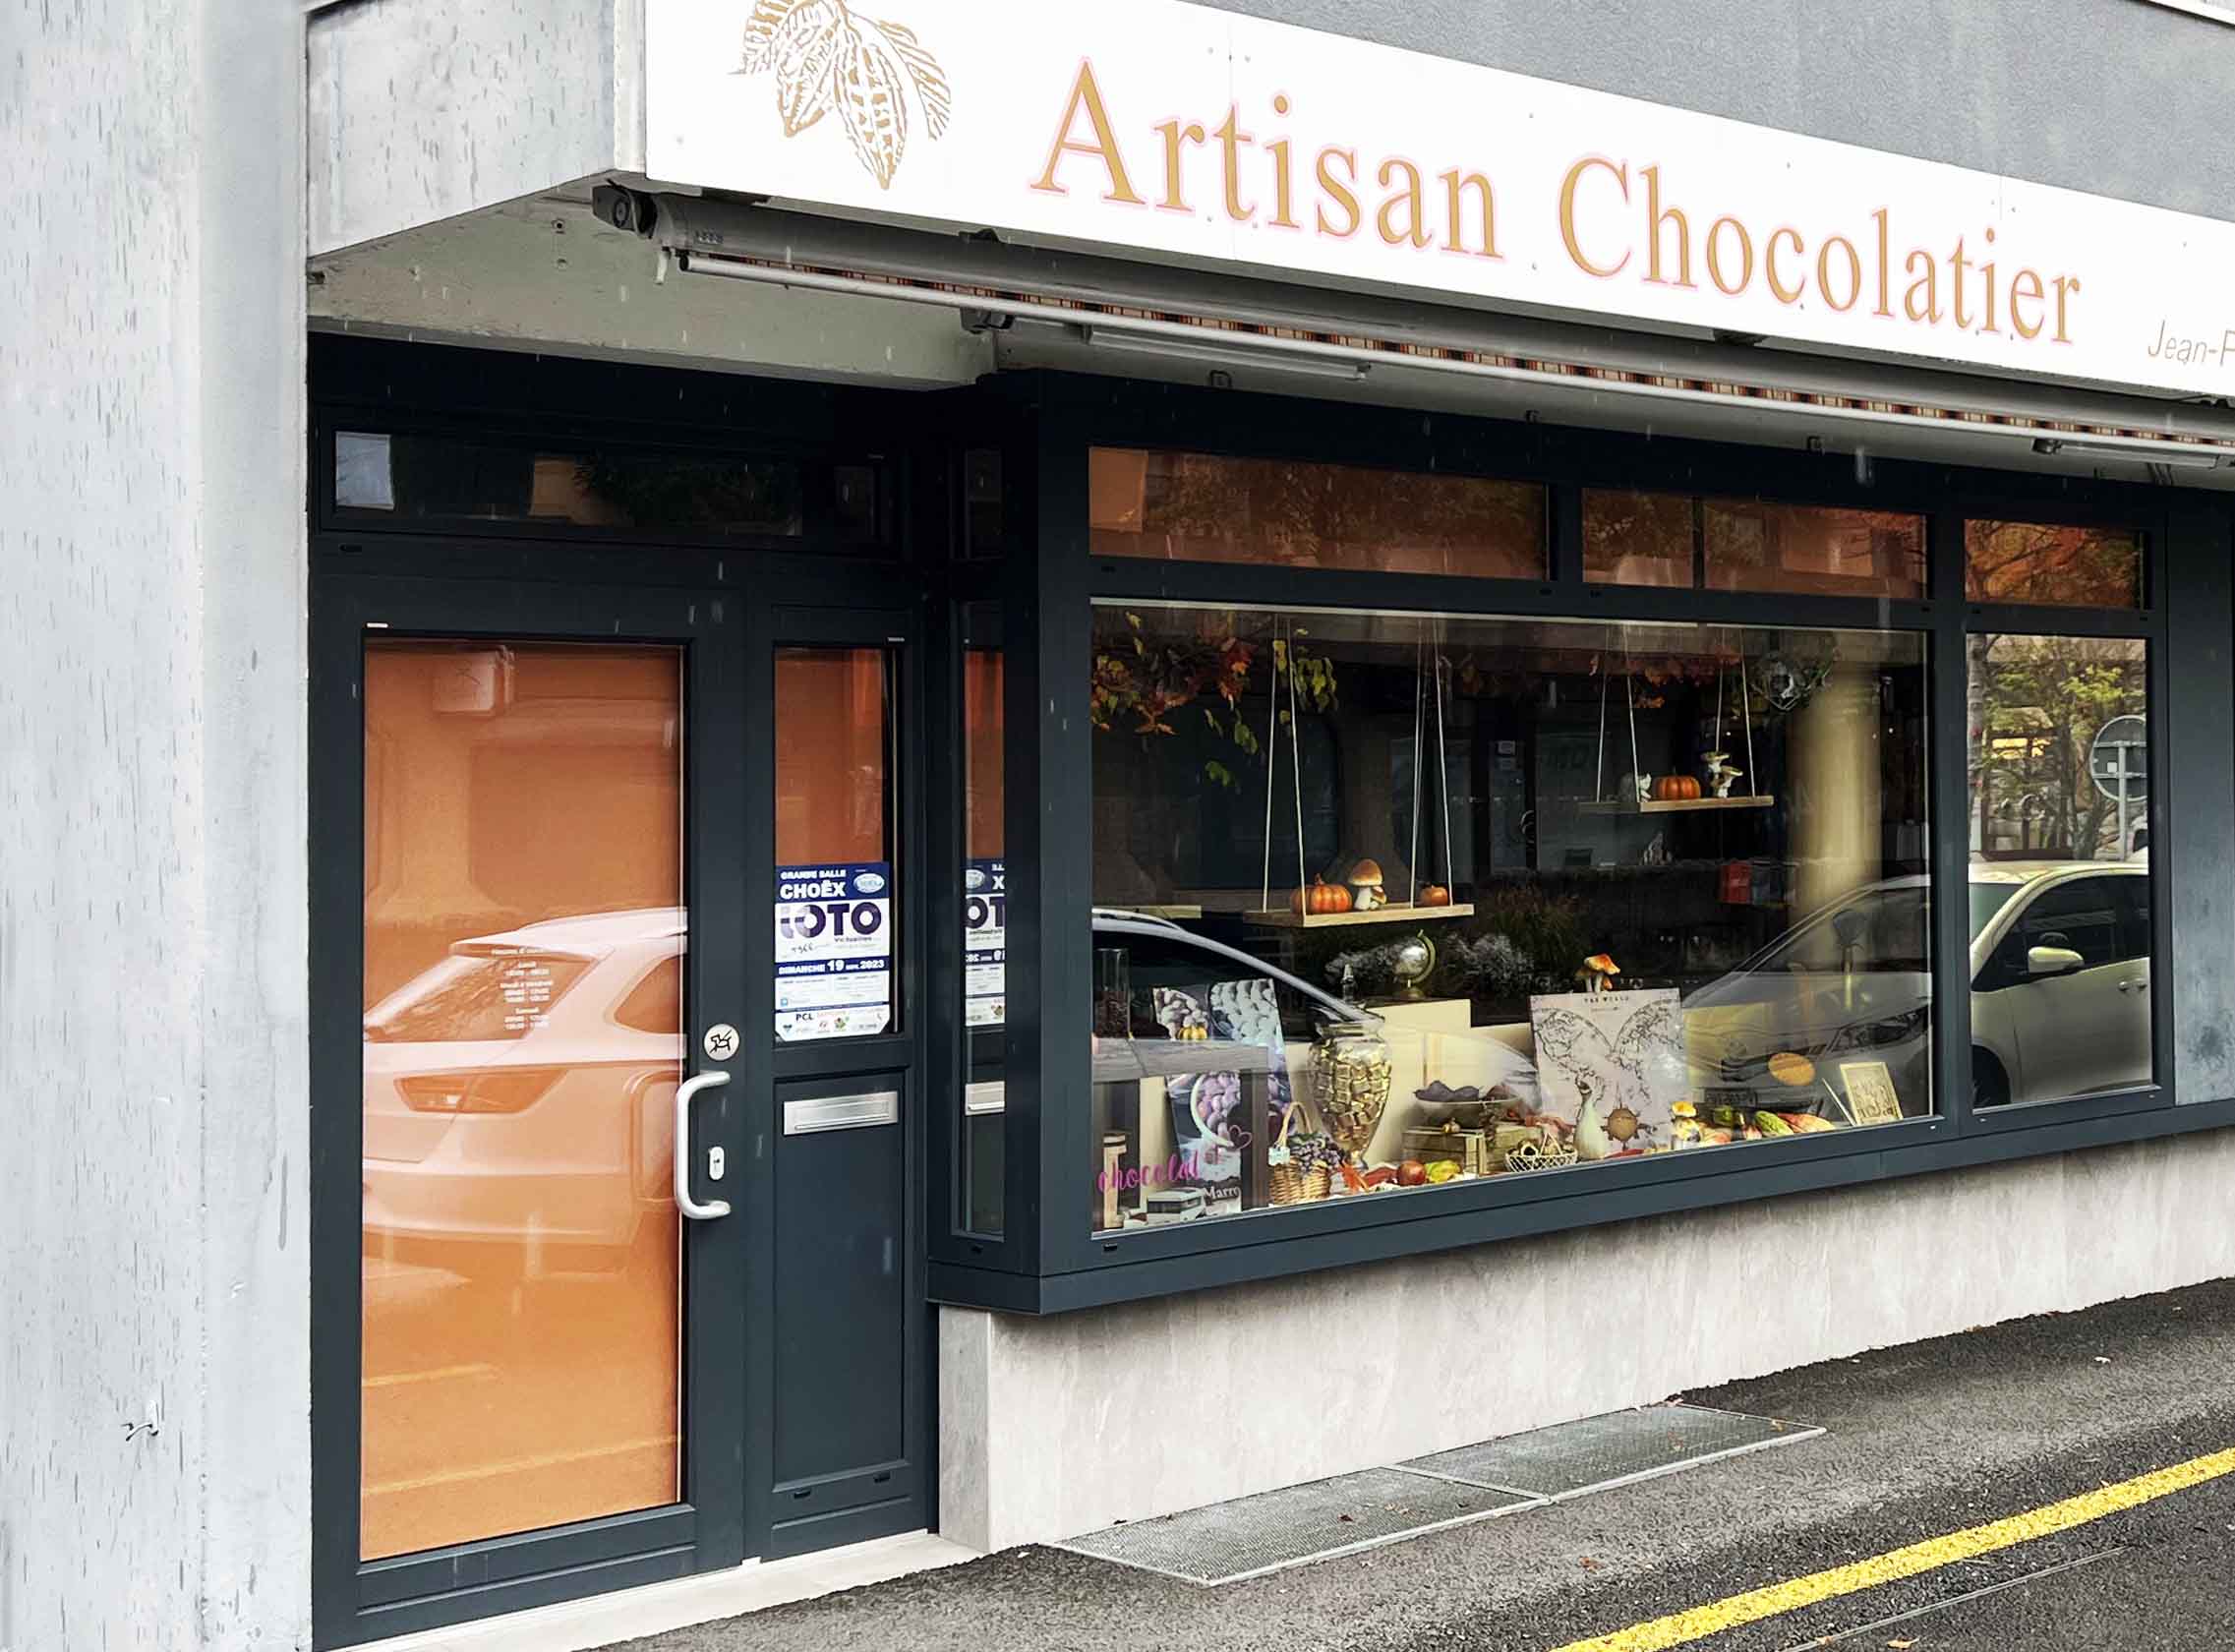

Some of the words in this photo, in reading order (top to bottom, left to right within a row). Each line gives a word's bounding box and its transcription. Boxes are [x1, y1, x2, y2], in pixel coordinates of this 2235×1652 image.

[1029, 56, 1504, 259] Artisan
[1558, 151, 2083, 345] Chocolatier
[819, 869, 847, 878] SALLE
[778, 965, 826, 975] DIMANCHE
[827, 960, 845, 972] 19
[859, 960, 885, 969] 2023
[795, 1012, 815, 1022] PCL
[1096, 1149, 1200, 1196] chocolat
